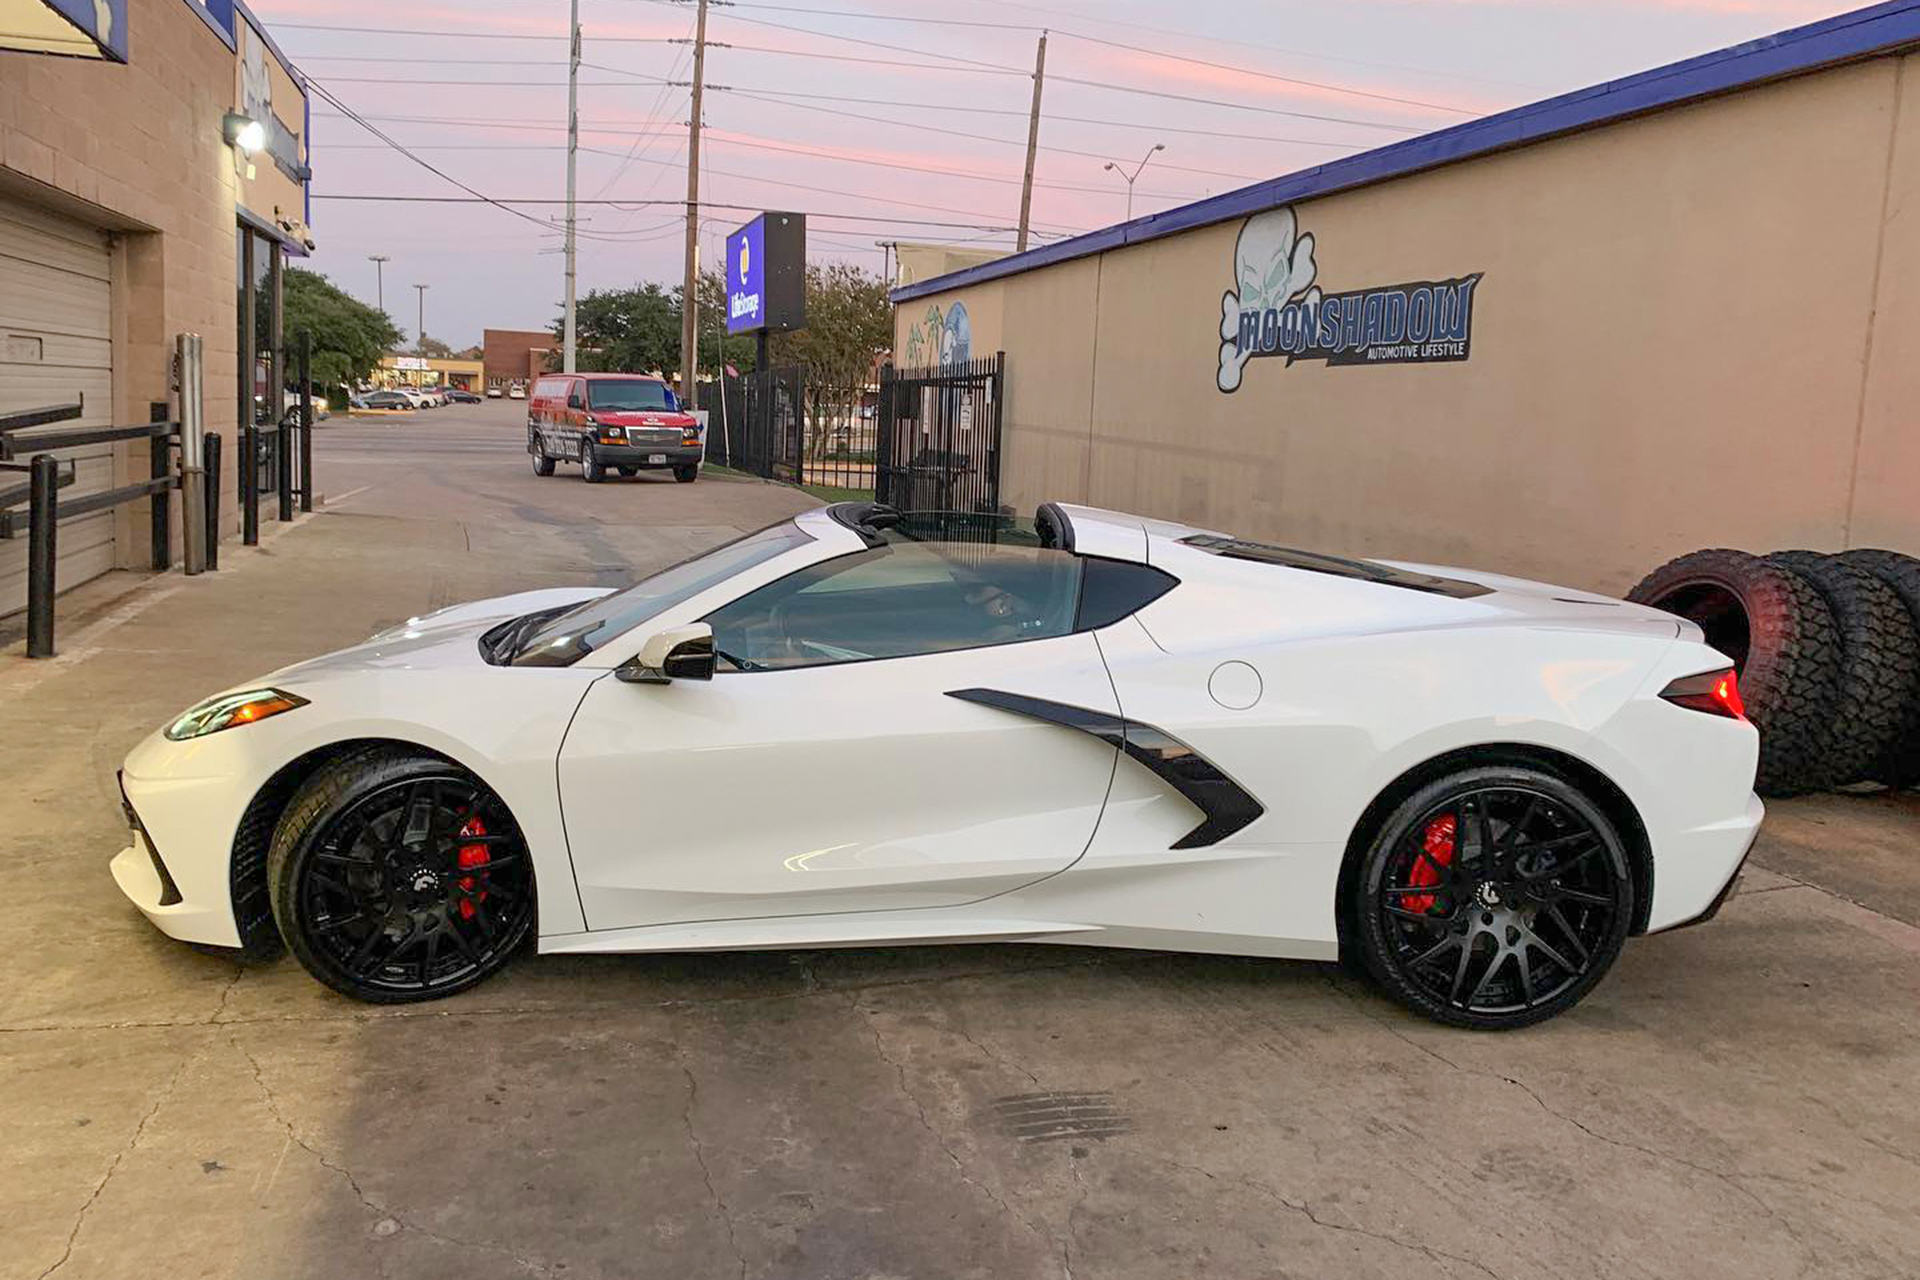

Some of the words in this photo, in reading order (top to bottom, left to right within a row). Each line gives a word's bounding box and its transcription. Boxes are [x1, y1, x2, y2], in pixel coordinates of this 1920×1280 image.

[1235, 278, 1476, 359] MOONSHADOW
[1367, 344, 1419, 360] AUTOMOTIVE
[1421, 342, 1465, 357] LIFESTYLE
